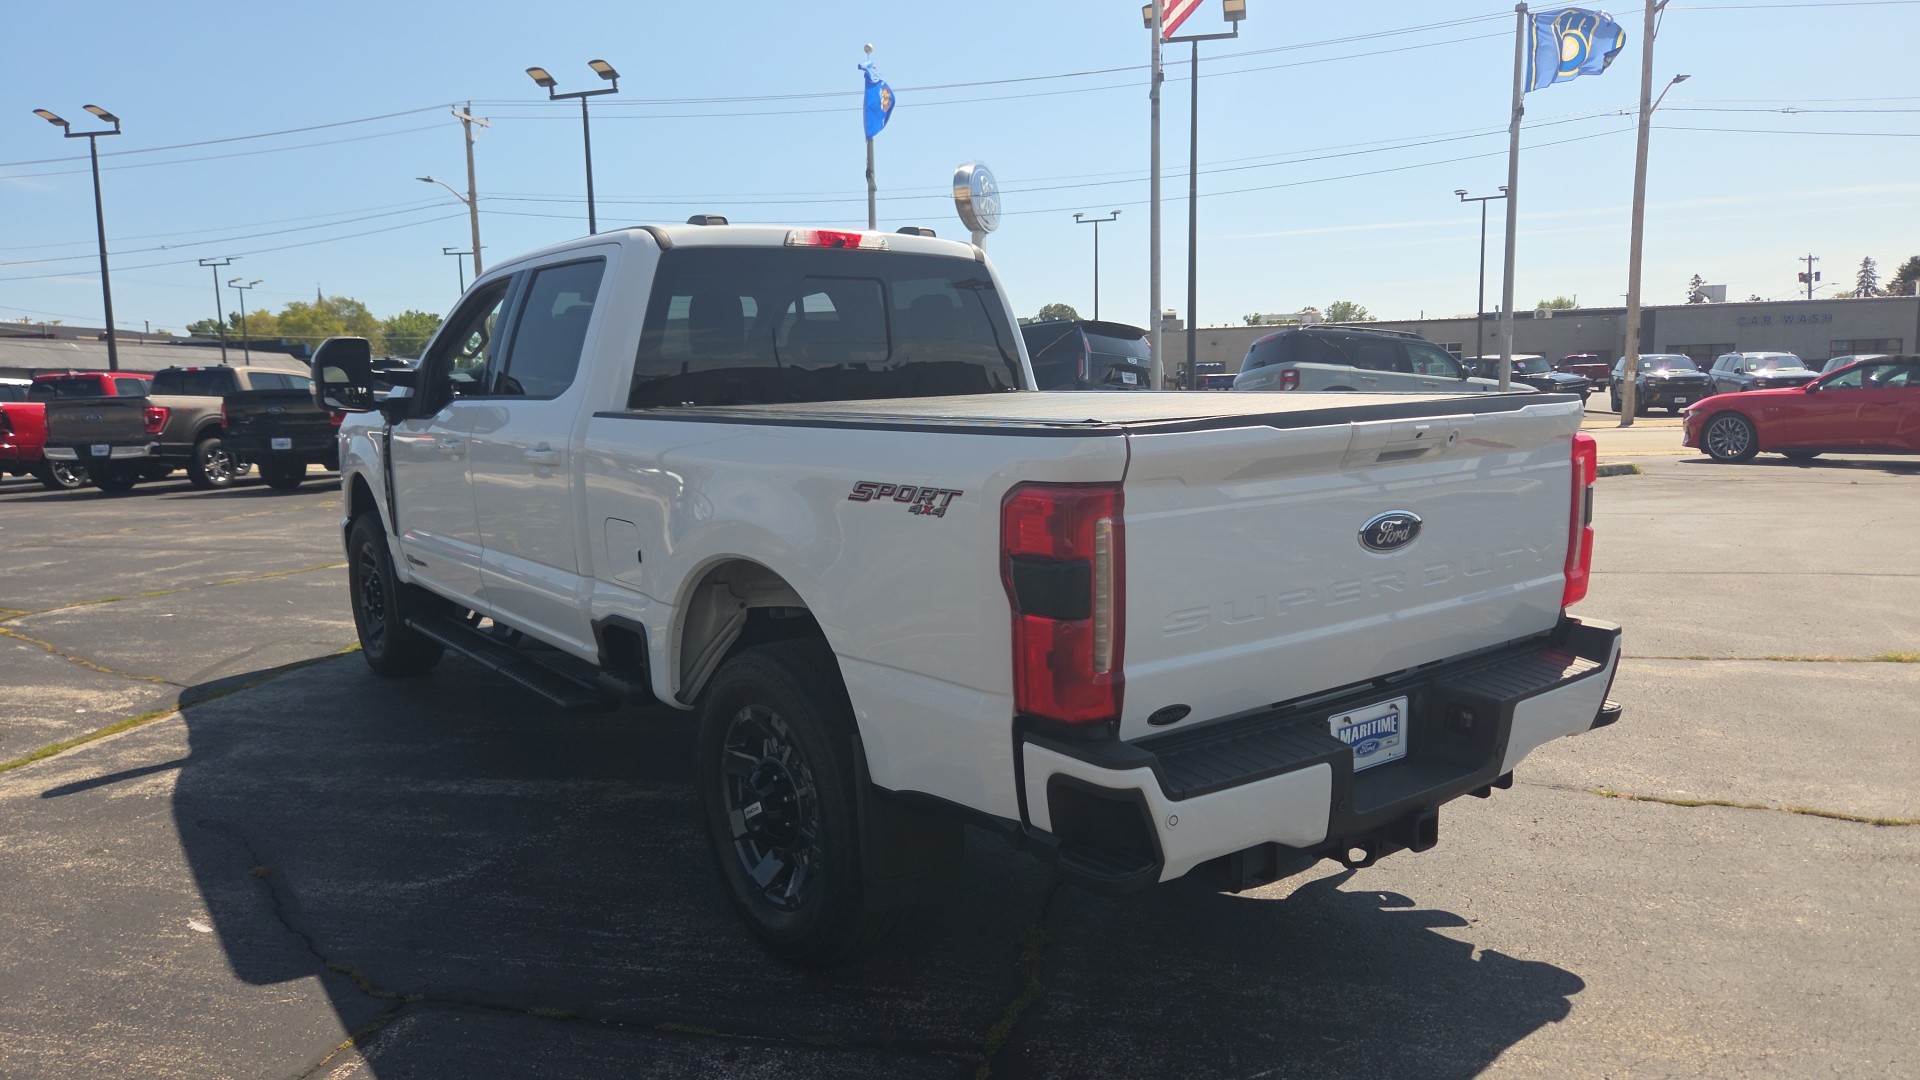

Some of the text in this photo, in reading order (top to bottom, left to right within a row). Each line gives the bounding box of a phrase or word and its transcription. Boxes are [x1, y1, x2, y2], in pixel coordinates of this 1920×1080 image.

[1738, 313, 1833, 326] CAR WASH
[848, 480, 964, 507] SPORT
[1376, 519, 1411, 545] Ford
[1162, 542, 1554, 638] SUPER DUTY
[1340, 714, 1397, 745] MARITIME
[1359, 741, 1378, 754] Ford
